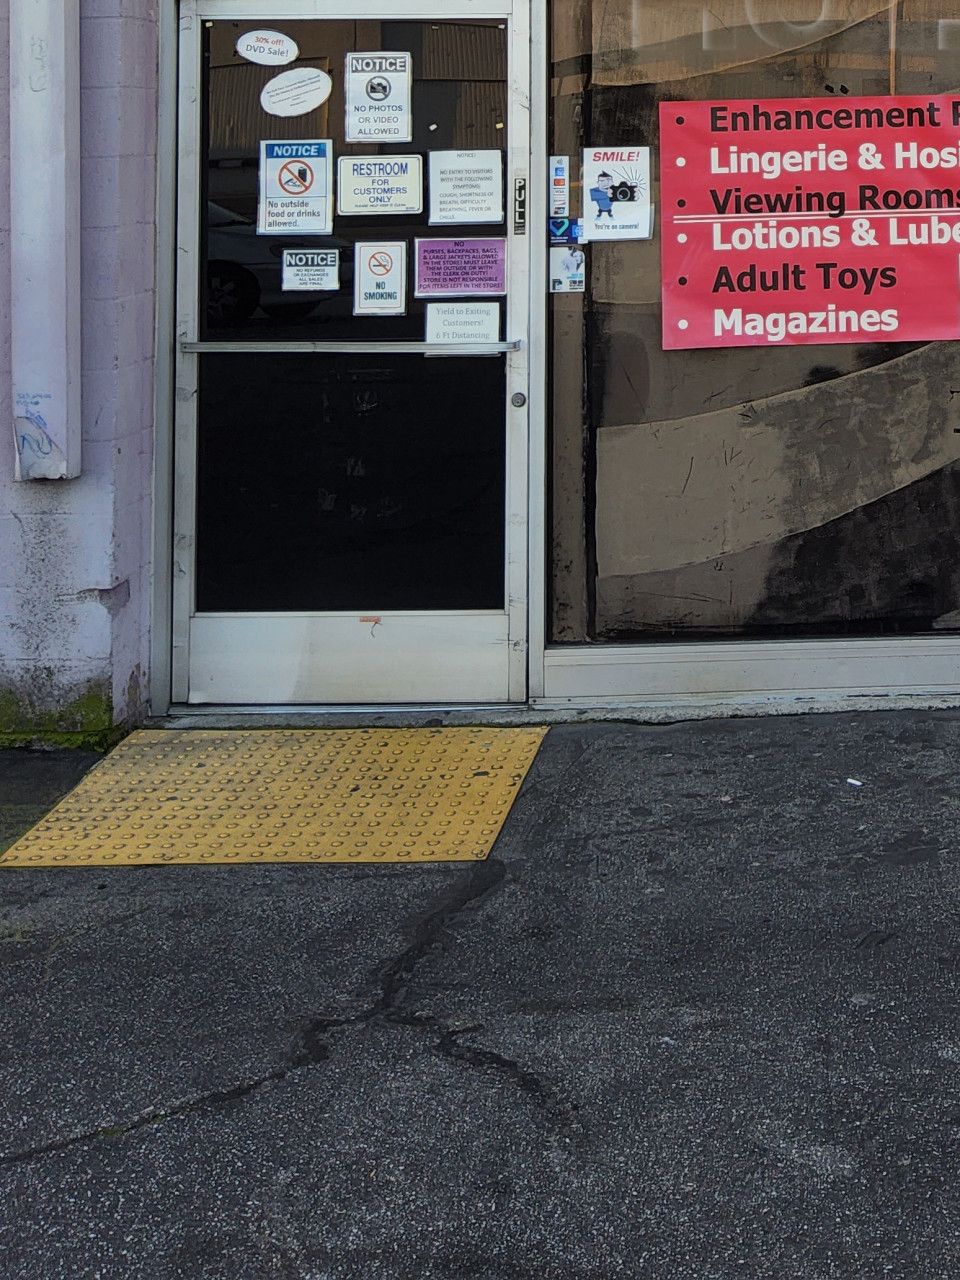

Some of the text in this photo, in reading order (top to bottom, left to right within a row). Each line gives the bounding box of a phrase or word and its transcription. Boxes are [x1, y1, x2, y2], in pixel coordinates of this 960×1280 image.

[255, 36, 283, 46] 30% off!
[246, 44, 288, 57] DVD Sale!
[352, 58, 406, 71] NOTICE
[710, 102, 941, 132] Enhancement
[274, 145, 319, 156] NOTICE
[593, 152, 640, 161] SMILE!
[710, 144, 848, 179] Lingerie
[858, 143, 885, 170] &
[353, 163, 408, 176] RESTROOM
[515, 179, 524, 222] PULL
[710, 186, 845, 217] Viewing
[712, 220, 840, 250] Lotions
[851, 218, 879, 246] &
[287, 254, 335, 265] NOTICE
[712, 263, 897, 295] Adult Toys
[364, 292, 397, 301] SMOKING
[436, 307, 454, 315] Yield
[466, 308, 490, 316] Exiting
[713, 304, 899, 341] Magazines
[452, 332, 490, 340] Distancing
